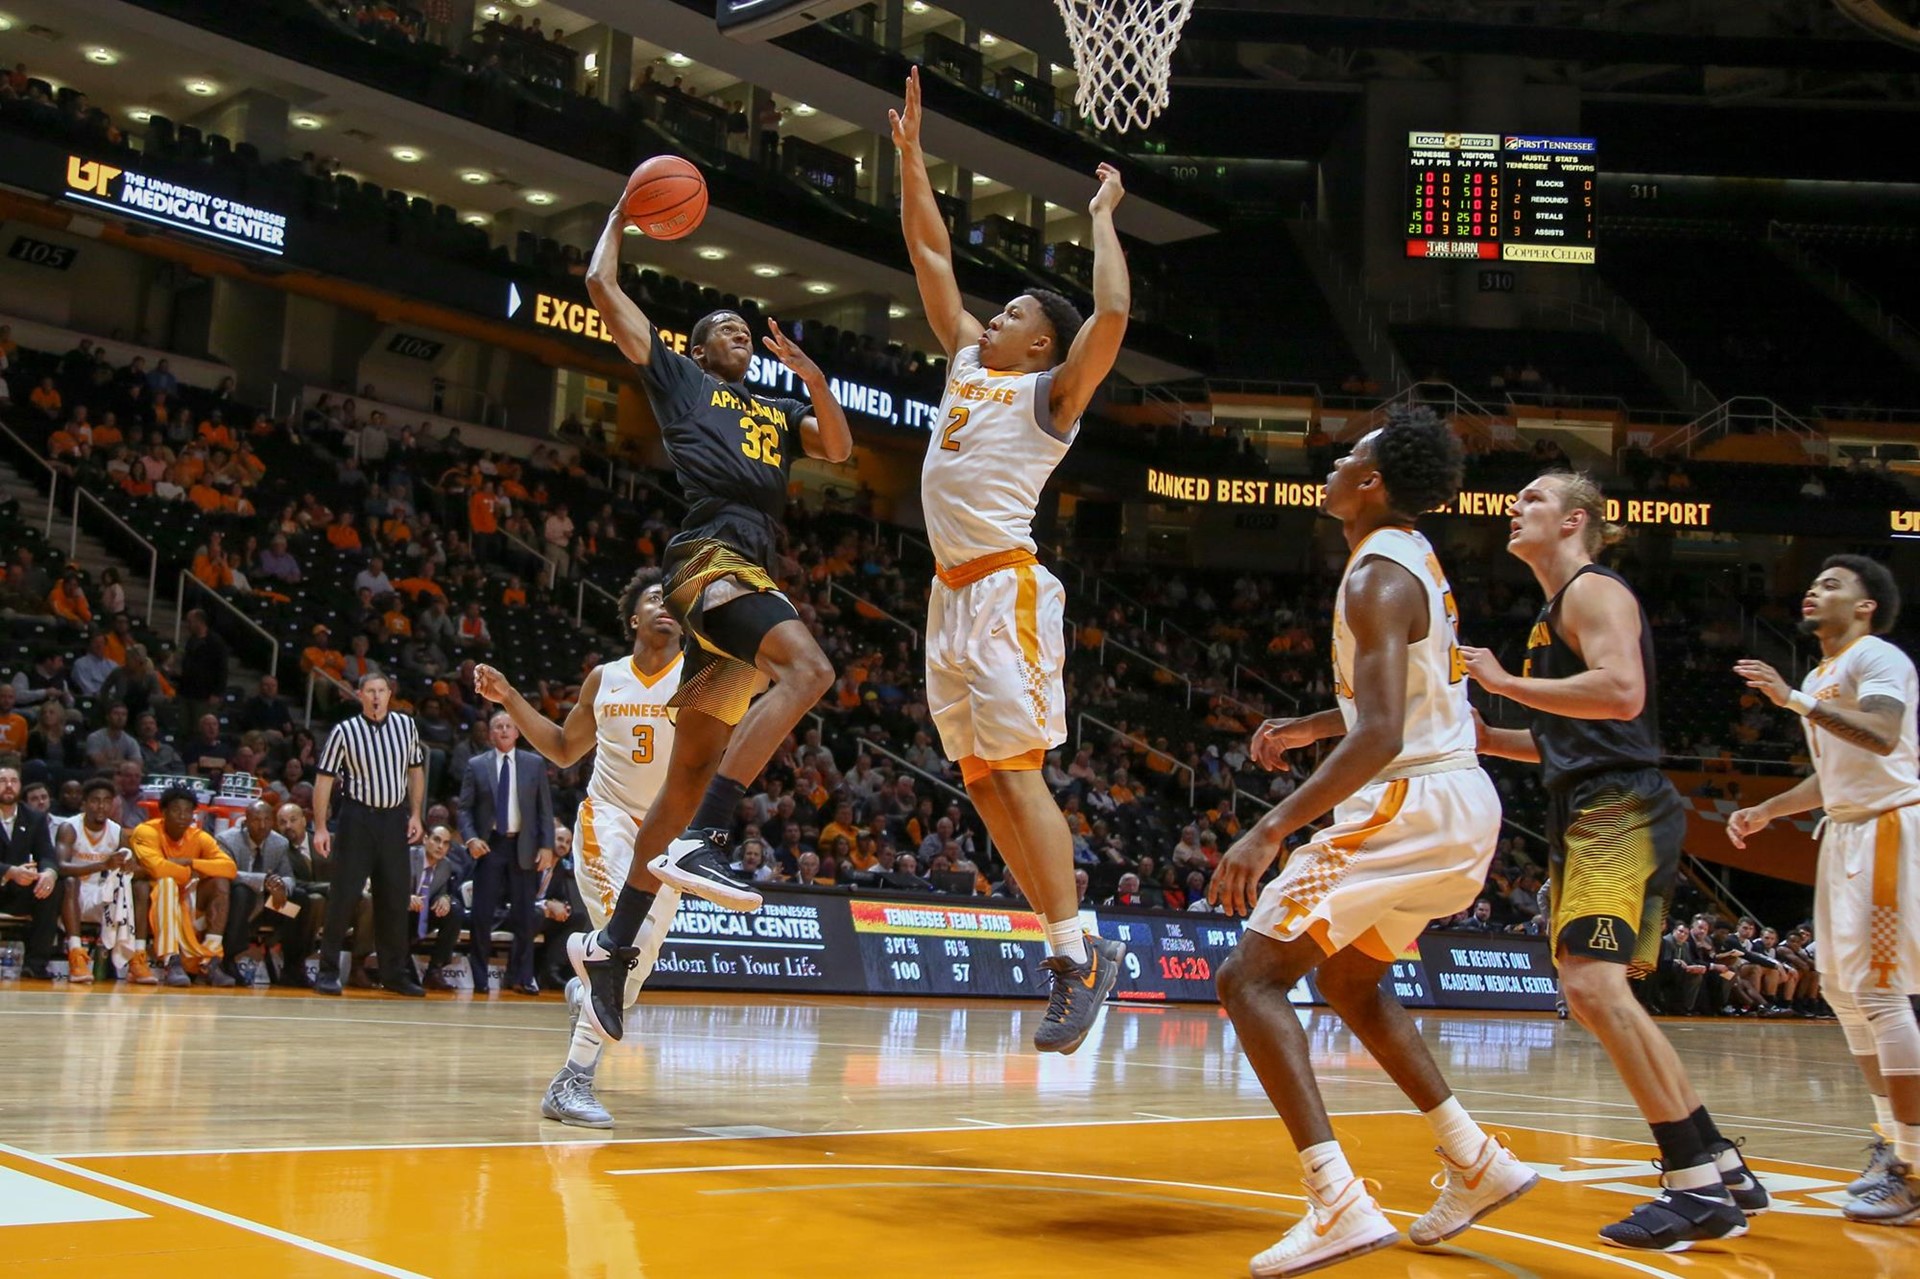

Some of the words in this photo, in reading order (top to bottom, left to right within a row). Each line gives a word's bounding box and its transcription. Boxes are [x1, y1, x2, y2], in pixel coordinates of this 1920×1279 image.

[1417, 137, 1444, 145] LOCAL
[1445, 134, 1460, 148] 8
[1518, 139, 1541, 149] FIRST
[1541, 140, 1594, 150] TENNESSEE
[1412, 151, 1450, 159] TENNESSEE
[1461, 152, 1495, 160] VISITORS
[1522, 154, 1551, 162] HUSTLE
[1555, 155, 1578, 163] STATS
[1506, 162, 1548, 170] TENNESSEE
[1561, 164, 1594, 172] VISITORS
[66, 155, 122, 197] UT
[1426, 172, 1434, 182] 0
[1443, 173, 1450, 183] 0
[1464, 174, 1470, 184] 2
[1474, 174, 1482, 184] 0
[1491, 175, 1498, 185] 5
[1416, 185, 1422, 195] 2
[1426, 185, 1434, 195] 0
[1443, 186, 1450, 196] 0
[1536, 180, 1564, 188] BLOCKS
[1584, 181, 1591, 190] 0
[1630, 184, 1658, 199] 311
[124, 171, 147, 188] THE
[147, 177, 212, 206] UNIVERSITY
[212, 197, 229, 211] OF
[229, 202, 287, 228] TENNESSEE
[1464, 187, 1470, 197] 5
[1474, 187, 1482, 197] 0
[1491, 188, 1498, 198] 0
[1514, 194, 1521, 204] 2
[1531, 196, 1568, 204] REBOUNDS
[1416, 198, 1422, 208] 3
[1425, 198, 1433, 208] 0
[1443, 199, 1450, 208] 4
[1474, 200, 1481, 210] 0
[1491, 201, 1497, 210] 2
[121, 184, 211, 226] MEDICAL
[213, 210, 285, 246] CENTER
[1412, 211, 1422, 220] 15
[1425, 211, 1433, 221] 0
[1442, 212, 1449, 222] 0
[1457, 213, 1470, 222] 25
[1473, 212, 1481, 223] 0
[1490, 214, 1497, 223] 0
[1514, 210, 1520, 220] 0
[1536, 212, 1564, 220] STEALS
[1409, 224, 1422, 234] 23
[1425, 224, 1433, 234] 0
[1443, 225, 1449, 235] 3
[1457, 226, 1470, 235] 32
[1473, 225, 1481, 235] 0
[1490, 226, 1497, 236] 0
[1514, 226, 1521, 236] 3
[1535, 228, 1564, 236] ASSISTS
[18, 240, 64, 267] 105
[1451, 242, 1478, 253] BARN
[1505, 245, 1549, 258] COPPER
[1551, 247, 1593, 260] CELLAR
[1481, 272, 1513, 289] 310
[398, 336, 433, 359] 106
[535, 293, 687, 355] EXCELCE
[742, 353, 797, 393] SN'T
[940, 406, 970, 452] 2
[739, 416, 782, 468] 32
[1148, 468, 1211, 502] RANKED
[1216, 479, 1269, 505] BEST
[1274, 483, 1328, 507] HOSP
[1458, 491, 1520, 517] NEWS
[1627, 499, 1712, 526] REPORT
[603, 703, 669, 719] TENNESS
[631, 724, 654, 764] 3
[764, 904, 818, 919] TENNESSEE
[669, 911, 753, 937] MEDICAL
[754, 917, 822, 940] CENTER
[883, 908, 947, 929] TENNESSEE
[947, 911, 978, 930] TEAM
[978, 914, 1013, 932] STATS
[1117, 925, 1132, 942] UT
[1207, 930, 1225, 946] APP
[1226, 931, 1238, 947] ST
[1589, 917, 1619, 951] A
[654, 951, 708, 974] isdom
[712, 952, 737, 974] for
[740, 954, 781, 976] Your
[785, 955, 823, 977] Life.
[1124, 952, 1141, 979] 9
[1450, 948, 1471, 967] THE
[1469, 950, 1511, 969] REGION'S
[1509, 952, 1532, 970] ONLY
[891, 961, 921, 980] 100
[952, 963, 970, 982] 57
[1012, 965, 1024, 984] 0
[1158, 955, 1211, 980] 16:20
[1407, 962, 1417, 978] 0
[1414, 982, 1424, 998] 0
[1439, 972, 1486, 992] ACADEMIC
[1484, 974, 1524, 993] MEDICAL
